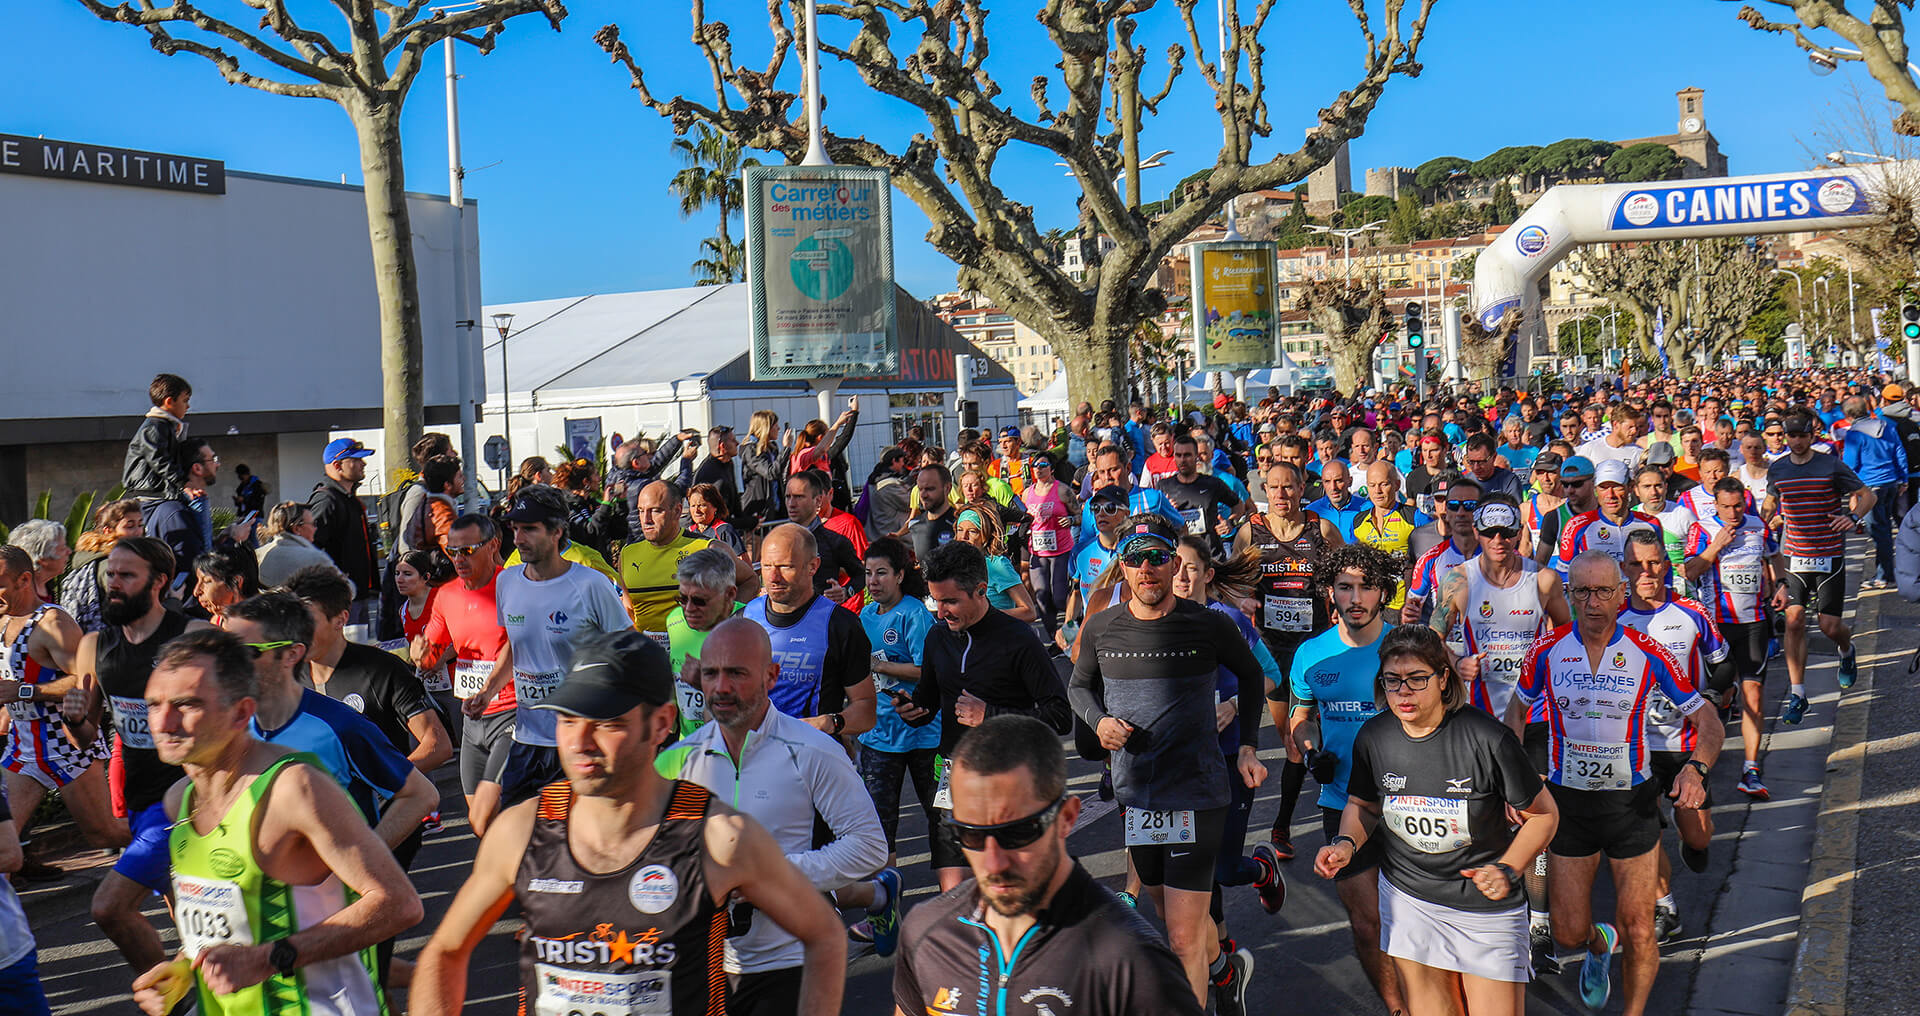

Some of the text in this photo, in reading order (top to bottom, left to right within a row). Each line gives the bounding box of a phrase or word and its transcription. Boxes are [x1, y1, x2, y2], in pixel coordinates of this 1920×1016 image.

[43, 144, 209, 187] MARITIME
[770, 183, 871, 204] Carrefour
[771, 200, 870, 221] des métiers
[1666, 182, 1811, 224] CANNES
[1798, 557, 1826, 567] 1413
[1728, 573, 1758, 585] 1354
[1275, 610, 1301, 623] 594
[460, 674, 485, 690] 888
[778, 668, 815, 685] réjus
[1574, 680, 1633, 695] Triathlon
[1327, 700, 1376, 712] INTERSP
[1572, 743, 1624, 755] INTERSPORT
[1576, 760, 1615, 779] 324
[1390, 804, 1415, 812] CANNES
[1422, 807, 1460, 816] MANDELIEU
[1397, 795, 1460, 809] INTERSPORT
[1141, 810, 1174, 830] 281
[1404, 815, 1447, 838] 605
[182, 908, 232, 939] 1033
